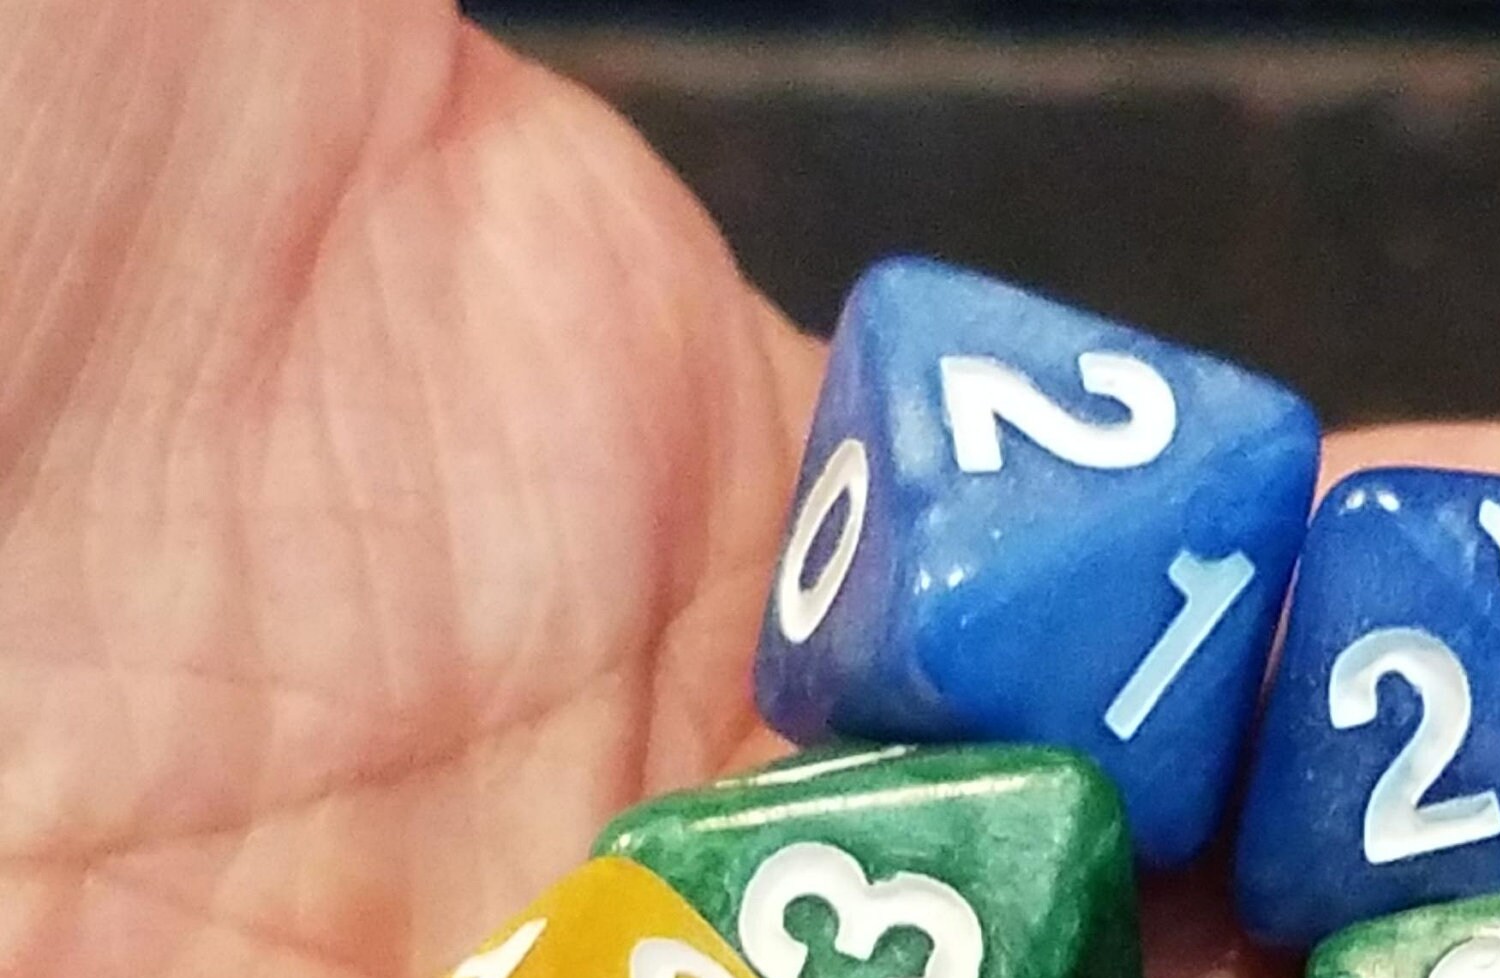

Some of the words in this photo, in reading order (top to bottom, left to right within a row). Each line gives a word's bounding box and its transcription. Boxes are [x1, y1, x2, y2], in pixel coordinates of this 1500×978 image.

[941, 352, 1176, 473] 2
[778, 438, 868, 643] 0
[1104, 550, 1255, 741] 1
